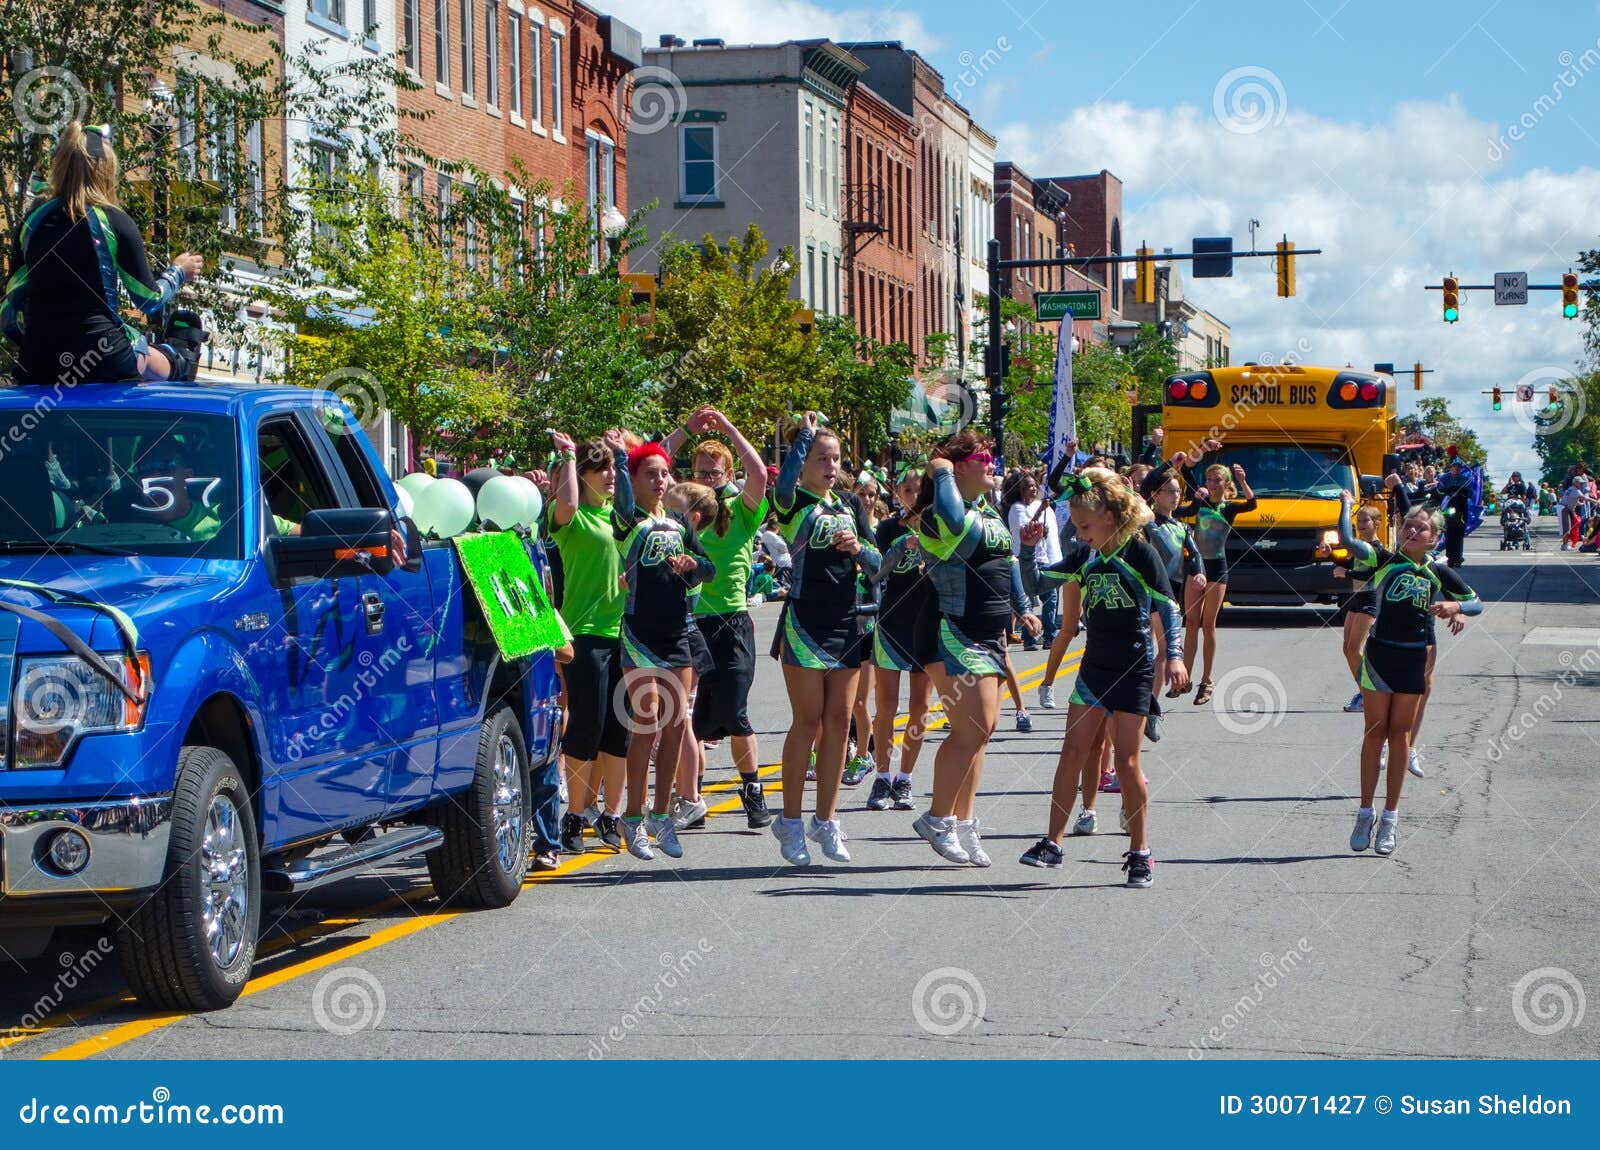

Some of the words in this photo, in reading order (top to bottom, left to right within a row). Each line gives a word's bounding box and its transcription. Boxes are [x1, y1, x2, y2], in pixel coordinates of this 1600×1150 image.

[1503, 277, 1519, 288] NO
[1497, 291, 1526, 300] TURNS
[1041, 302, 1087, 312] WASHINGTON
[1087, 301, 1097, 310] ST
[1231, 384, 1285, 405] SCHOOL
[1289, 385, 1317, 405] BUS
[131, 476, 222, 512] 57
